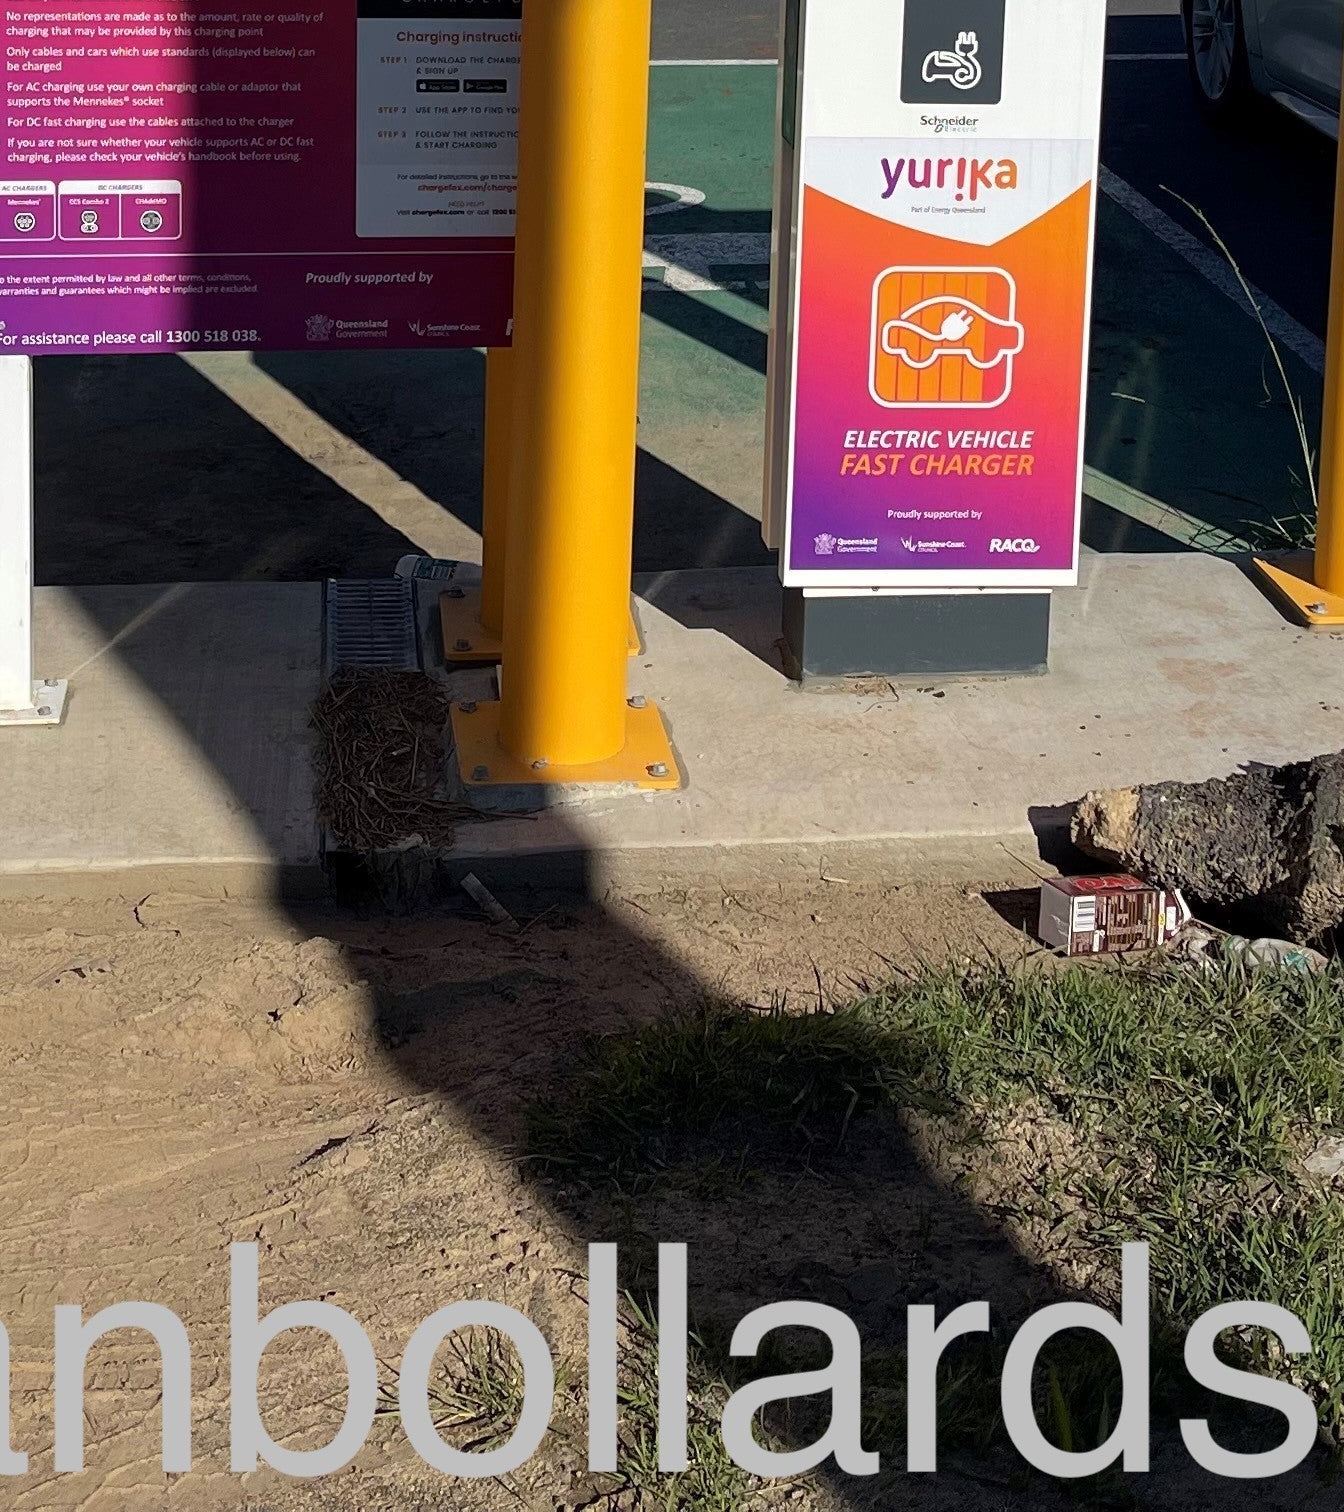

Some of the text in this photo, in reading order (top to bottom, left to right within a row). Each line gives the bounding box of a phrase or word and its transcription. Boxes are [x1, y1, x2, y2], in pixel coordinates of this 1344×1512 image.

[397, 30, 521, 45] Charging instructi
[7, 97, 51, 107] supports
[54, 96, 70, 106] the
[132, 97, 164, 106] socket
[920, 115, 979, 125] Schneider
[306, 271, 432, 285] Proudly supported by
[336, 319, 388, 329] Queensland
[22, 331, 89, 346] assistance
[94, 331, 136, 347] please
[140, 330, 162, 343] call
[166, 331, 200, 343] 1300
[204, 330, 228, 342] 518
[232, 329, 261, 342] 038.
[336, 329, 387, 339] Government
[844, 430, 1034, 449] ELECTRIC VEHICLE
[840, 454, 1034, 476] FAST CHARGER
[888, 509, 982, 520] Proudly supported by
[837, 538, 878, 546] Queensland
[989, 538, 1040, 552] RACQ
